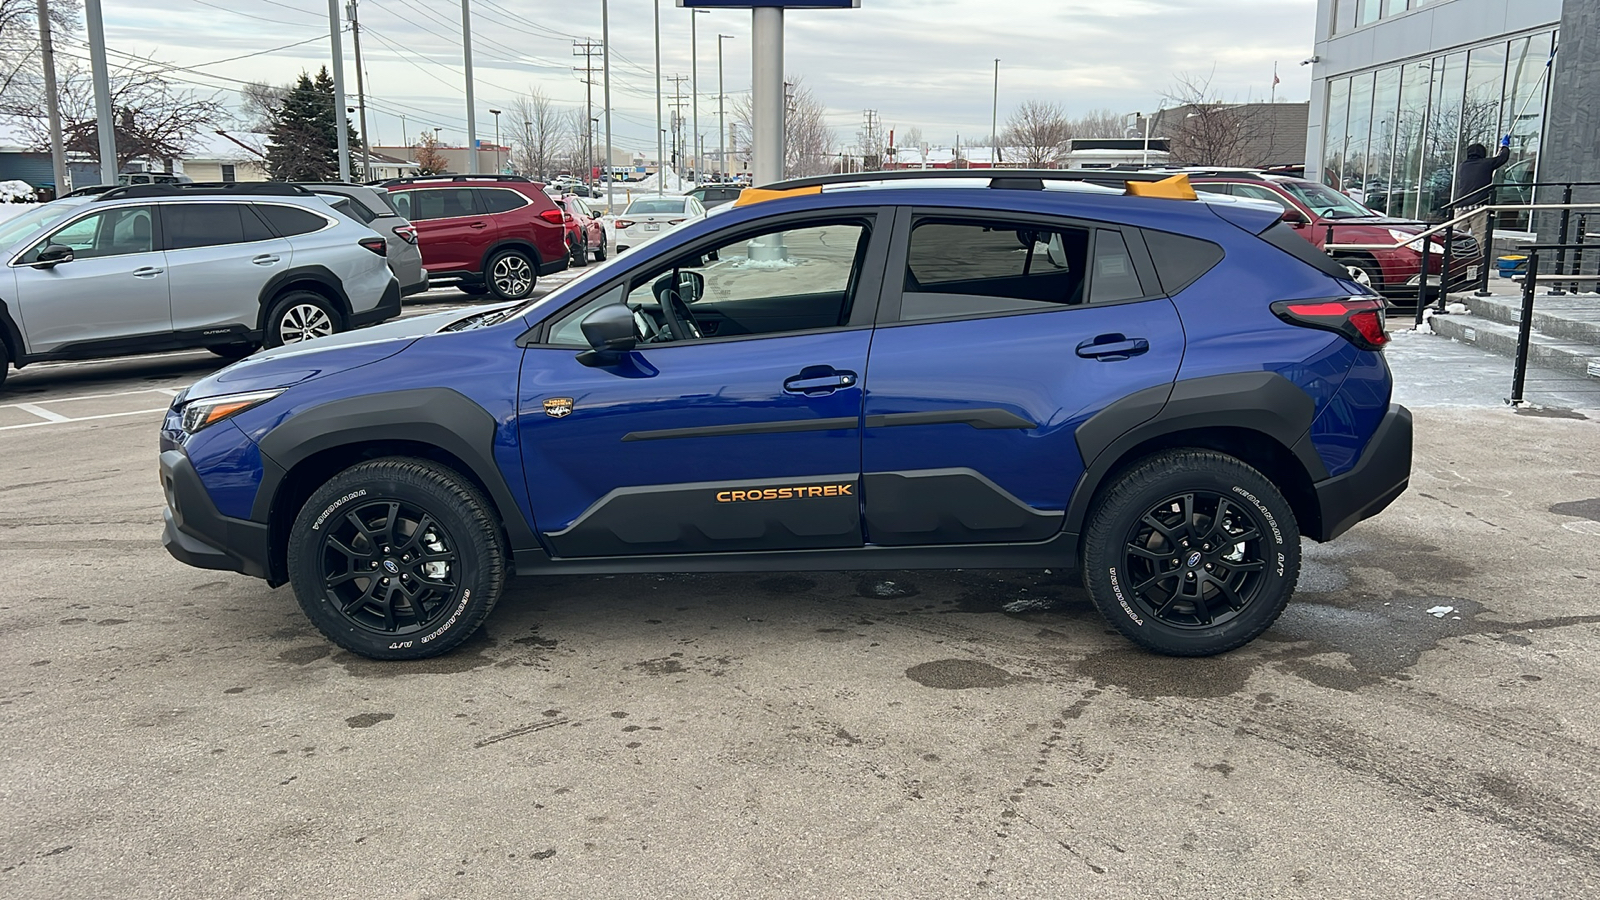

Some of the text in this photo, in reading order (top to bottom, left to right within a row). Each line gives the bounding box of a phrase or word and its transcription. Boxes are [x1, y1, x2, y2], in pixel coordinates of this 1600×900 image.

[312, 489, 367, 530] YOKOHAMA
[716, 484, 853, 502] CROSSTREK
[1232, 486, 1285, 577] GEOLANDAR A/T
[389, 588, 471, 649] GEOLANDAR A/T
[1109, 567, 1144, 626] YOKOHAMA
